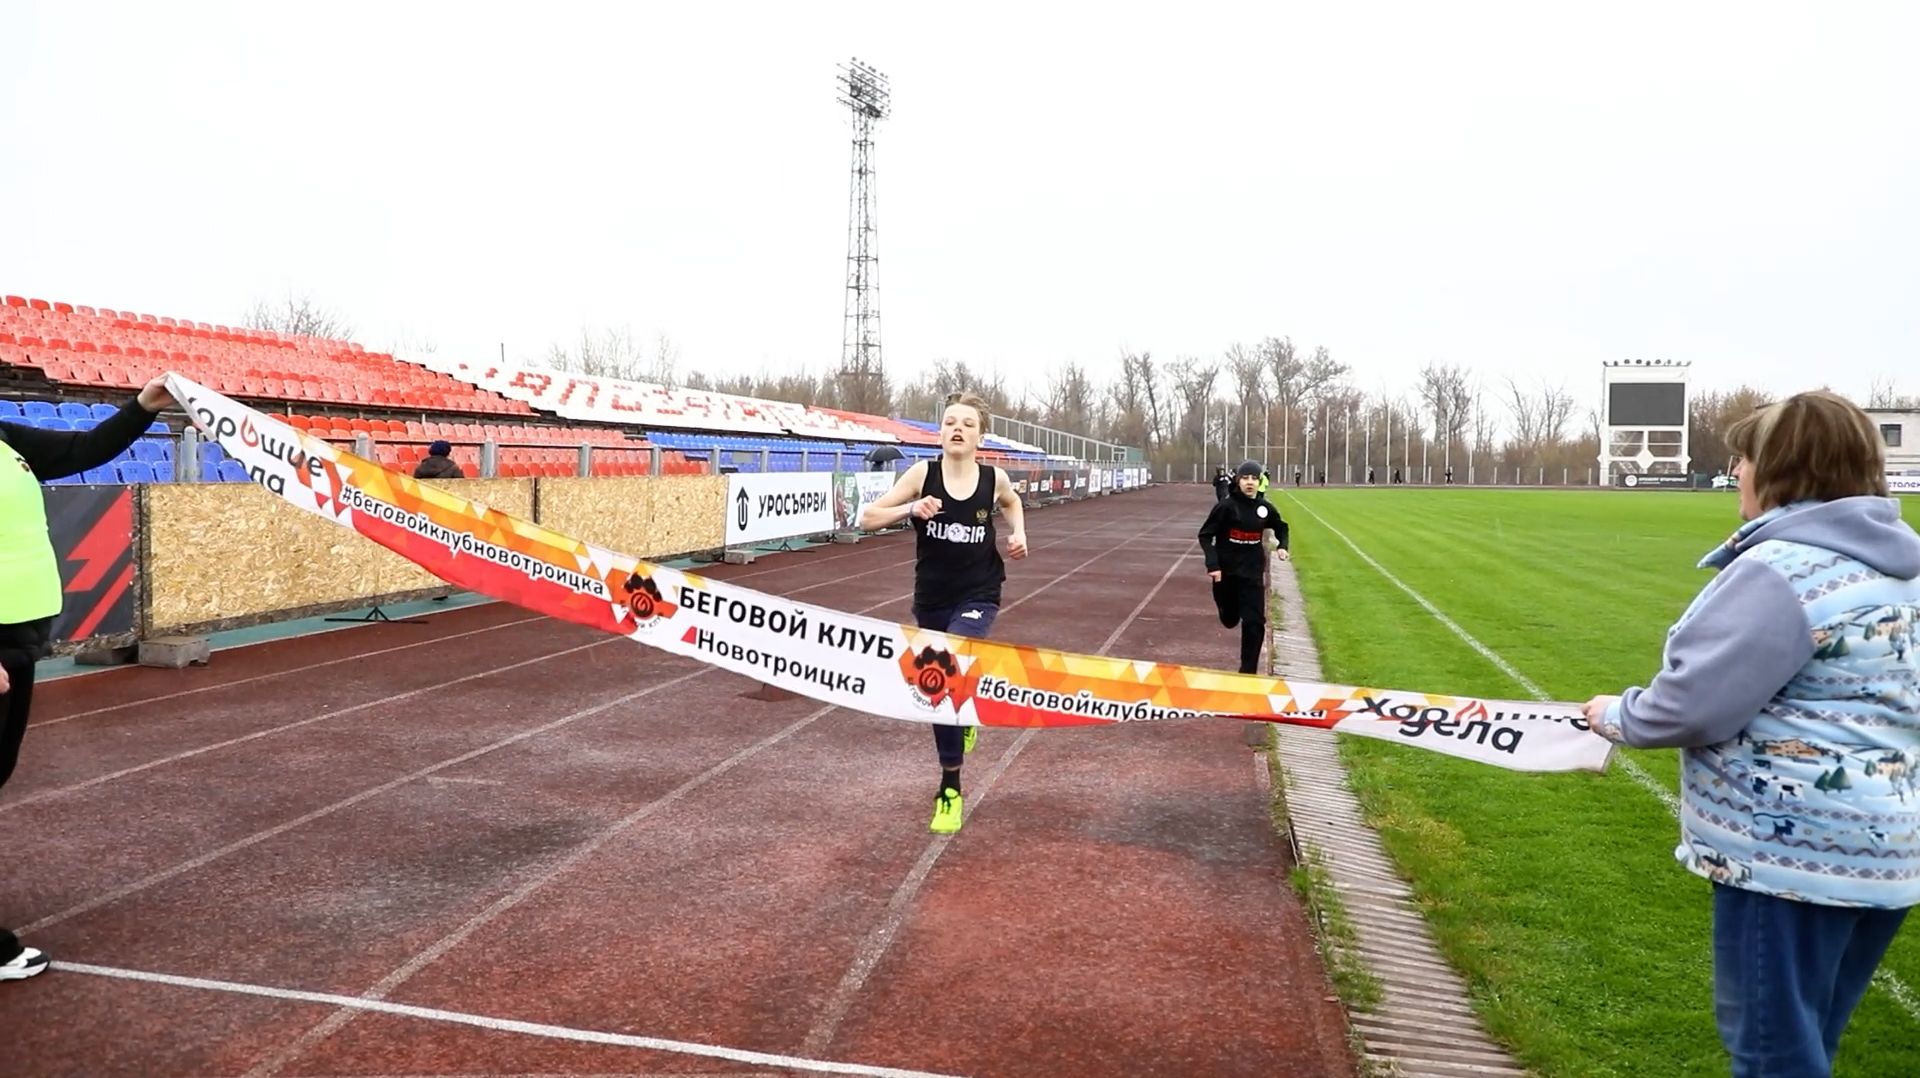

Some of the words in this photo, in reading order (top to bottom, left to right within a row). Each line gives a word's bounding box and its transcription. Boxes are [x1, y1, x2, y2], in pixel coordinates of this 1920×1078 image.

[758, 491, 827, 518] УРОСЪЯРВИ
[926, 520, 986, 544] RUSIA
[342, 486, 604, 596] #беговойклубновотроицка
[679, 586, 808, 640] БЕГОВОЙ
[817, 622, 895, 660] КЛУБ
[698, 629, 866, 695] Новотроицка
